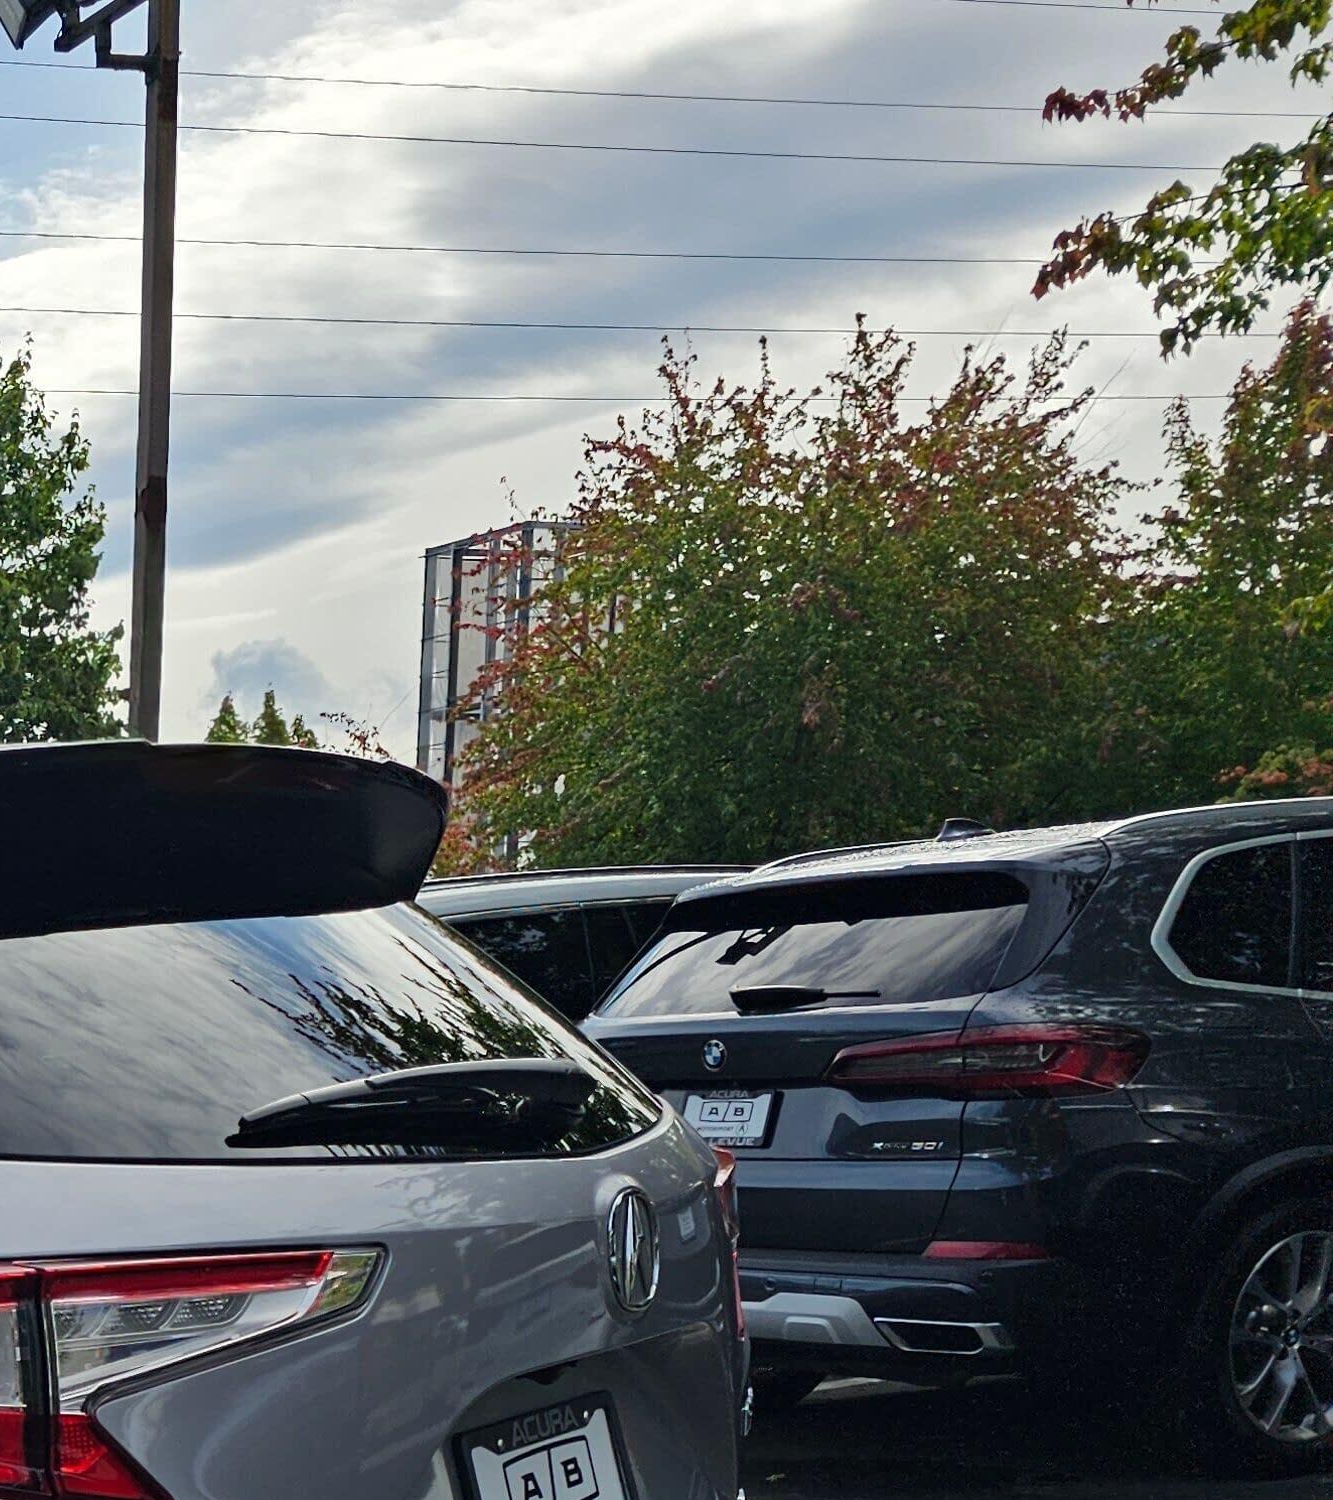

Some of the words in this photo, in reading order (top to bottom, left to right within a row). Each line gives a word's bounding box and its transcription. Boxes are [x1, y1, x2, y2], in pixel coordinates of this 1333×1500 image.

[709, 1090, 749, 1098] ACURA
[708, 1107, 719, 1116] A
[733, 1107, 744, 1116] B
[512, 1405, 579, 1447] ACURA
[560, 1457, 583, 1489] B
